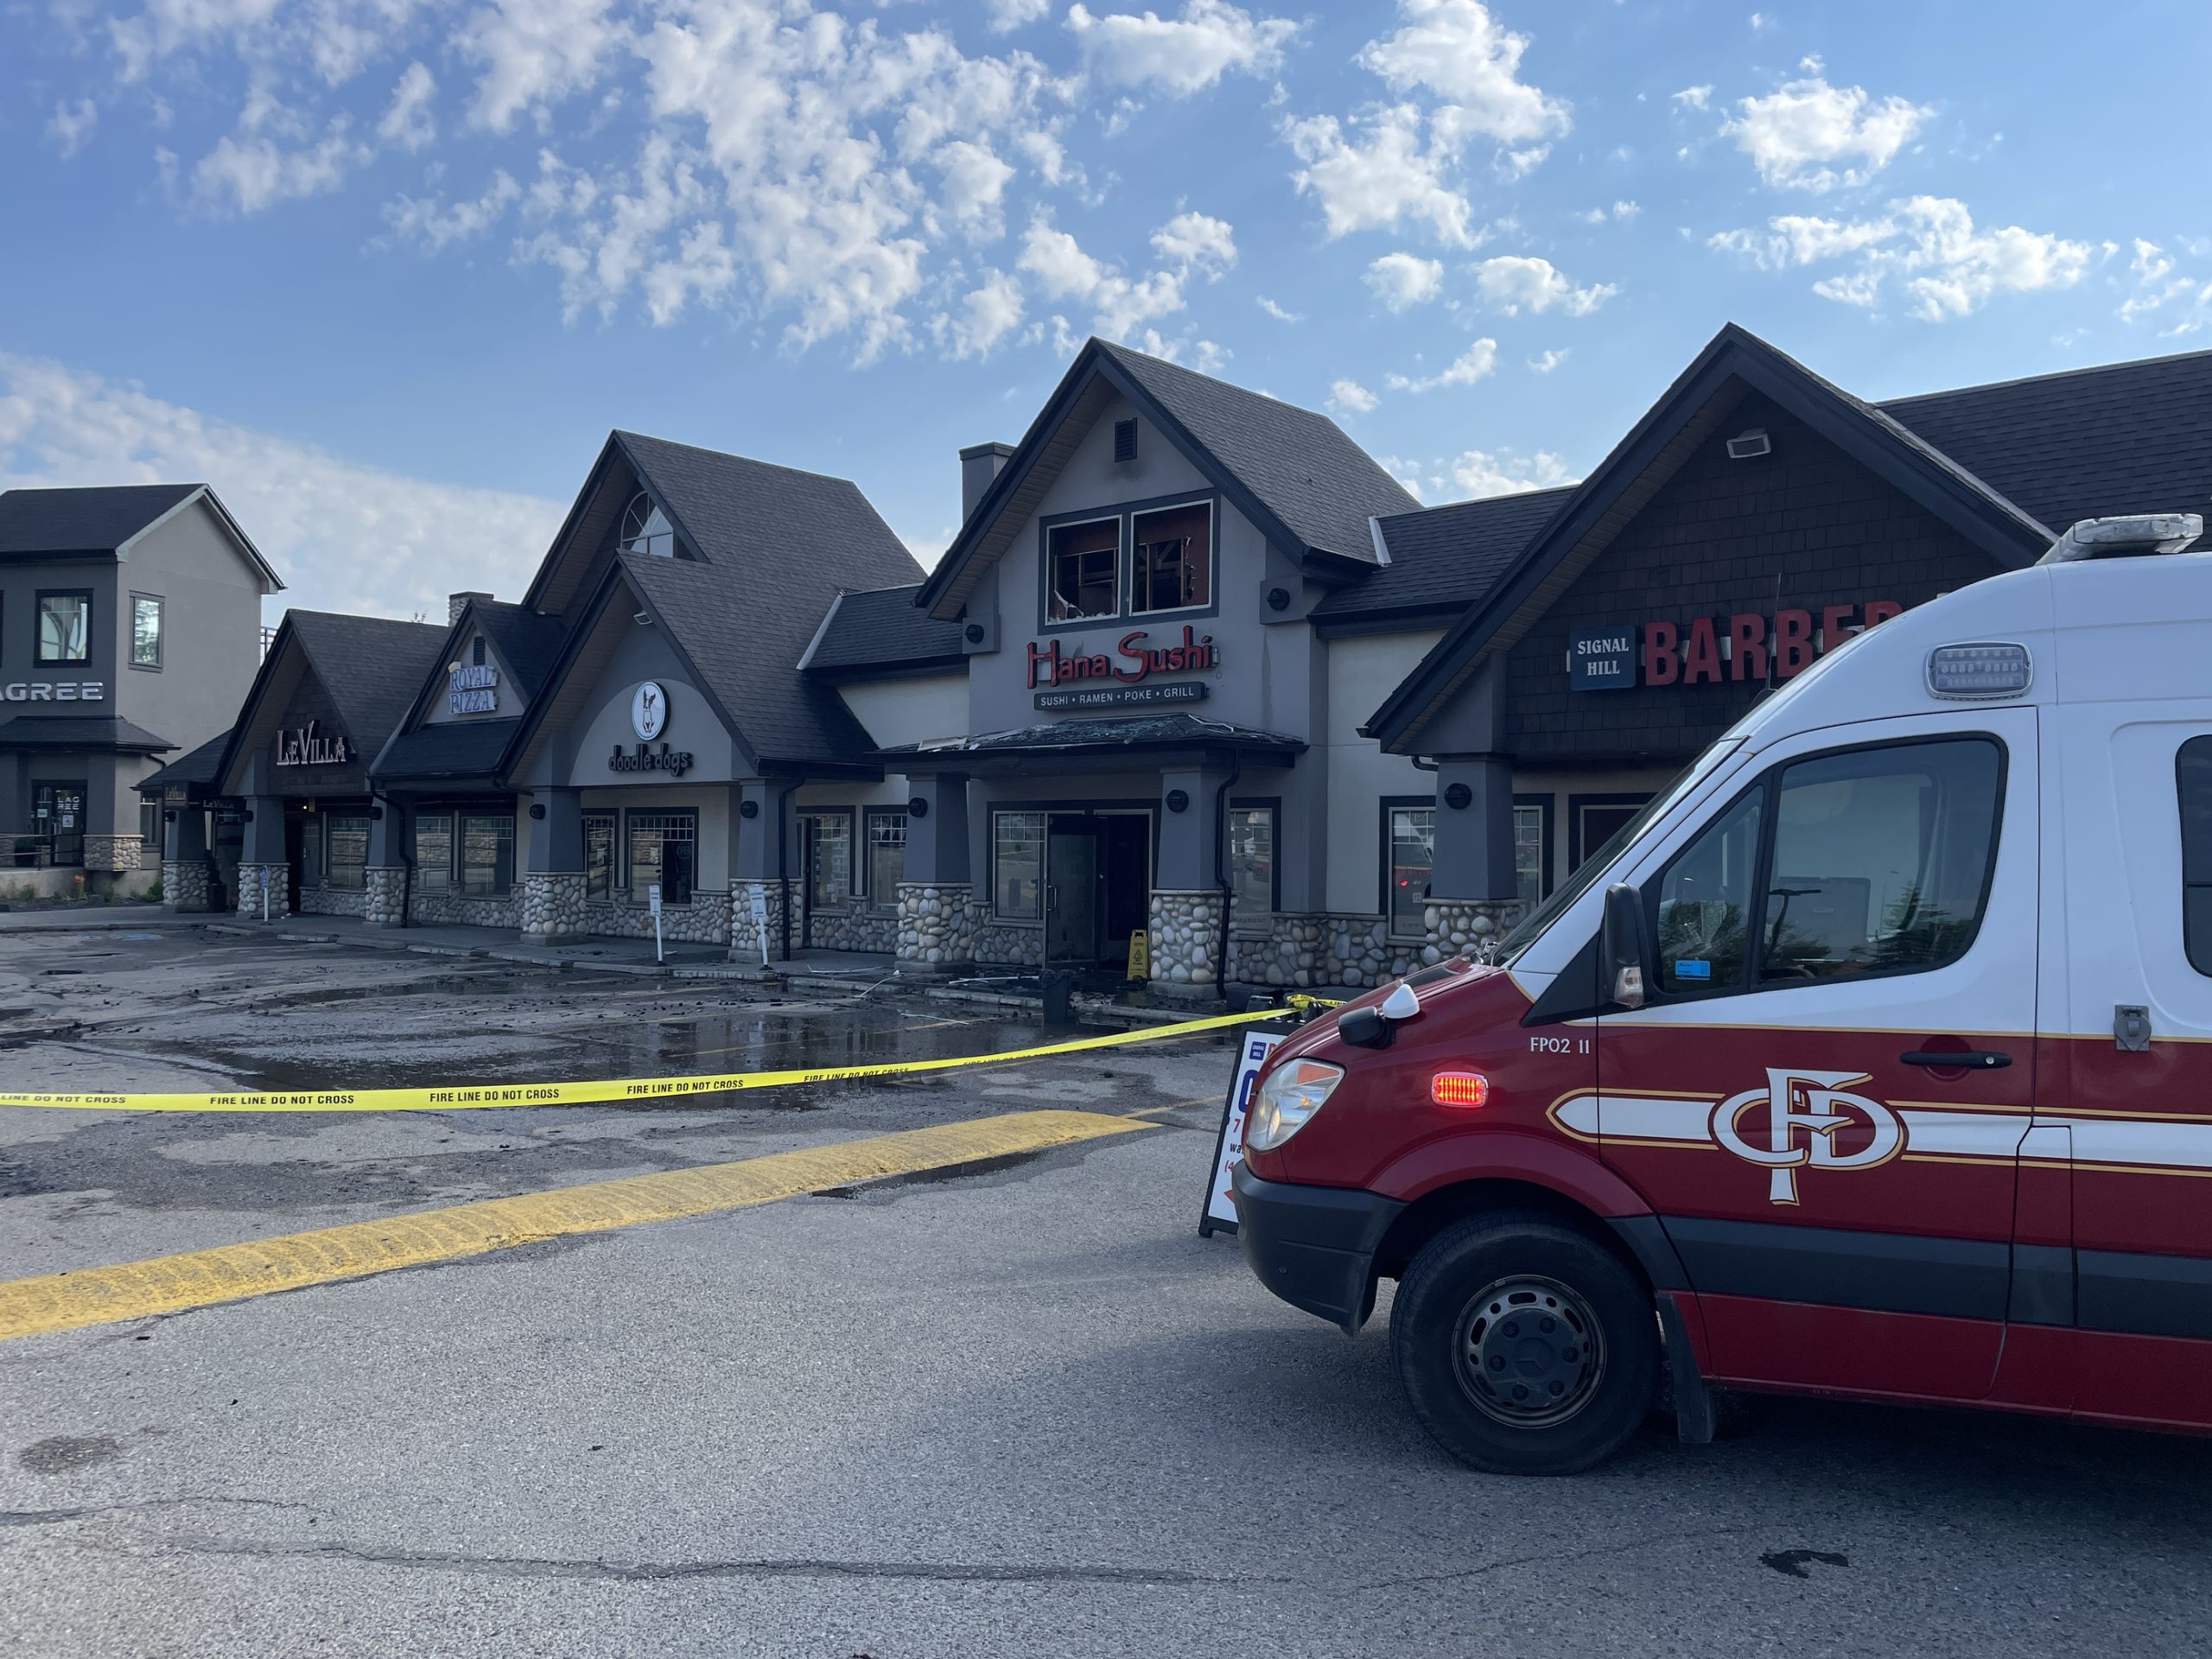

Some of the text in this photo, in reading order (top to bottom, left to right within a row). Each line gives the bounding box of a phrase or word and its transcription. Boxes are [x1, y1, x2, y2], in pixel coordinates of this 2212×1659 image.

[1577, 637, 1630, 655] SIGNAL
[1027, 625, 1213, 690] Hana Sushi
[450, 666, 494, 690] ROYAL
[1586, 660, 1621, 676] HILL
[0, 682, 104, 702] GREE
[449, 690, 491, 714] PIZZA
[1040, 686, 1195, 707] SUSHI RAMEN POKE GRILL
[608, 742, 693, 778] doodle dogs
[429, 1089, 560, 1103] FIRE LINE DO NOT CROSS
[626, 1079, 744, 1095] FIRE LINE DO NOT CROSS
[210, 1095, 354, 1105] FIRE LINE DO NOT CROSS
